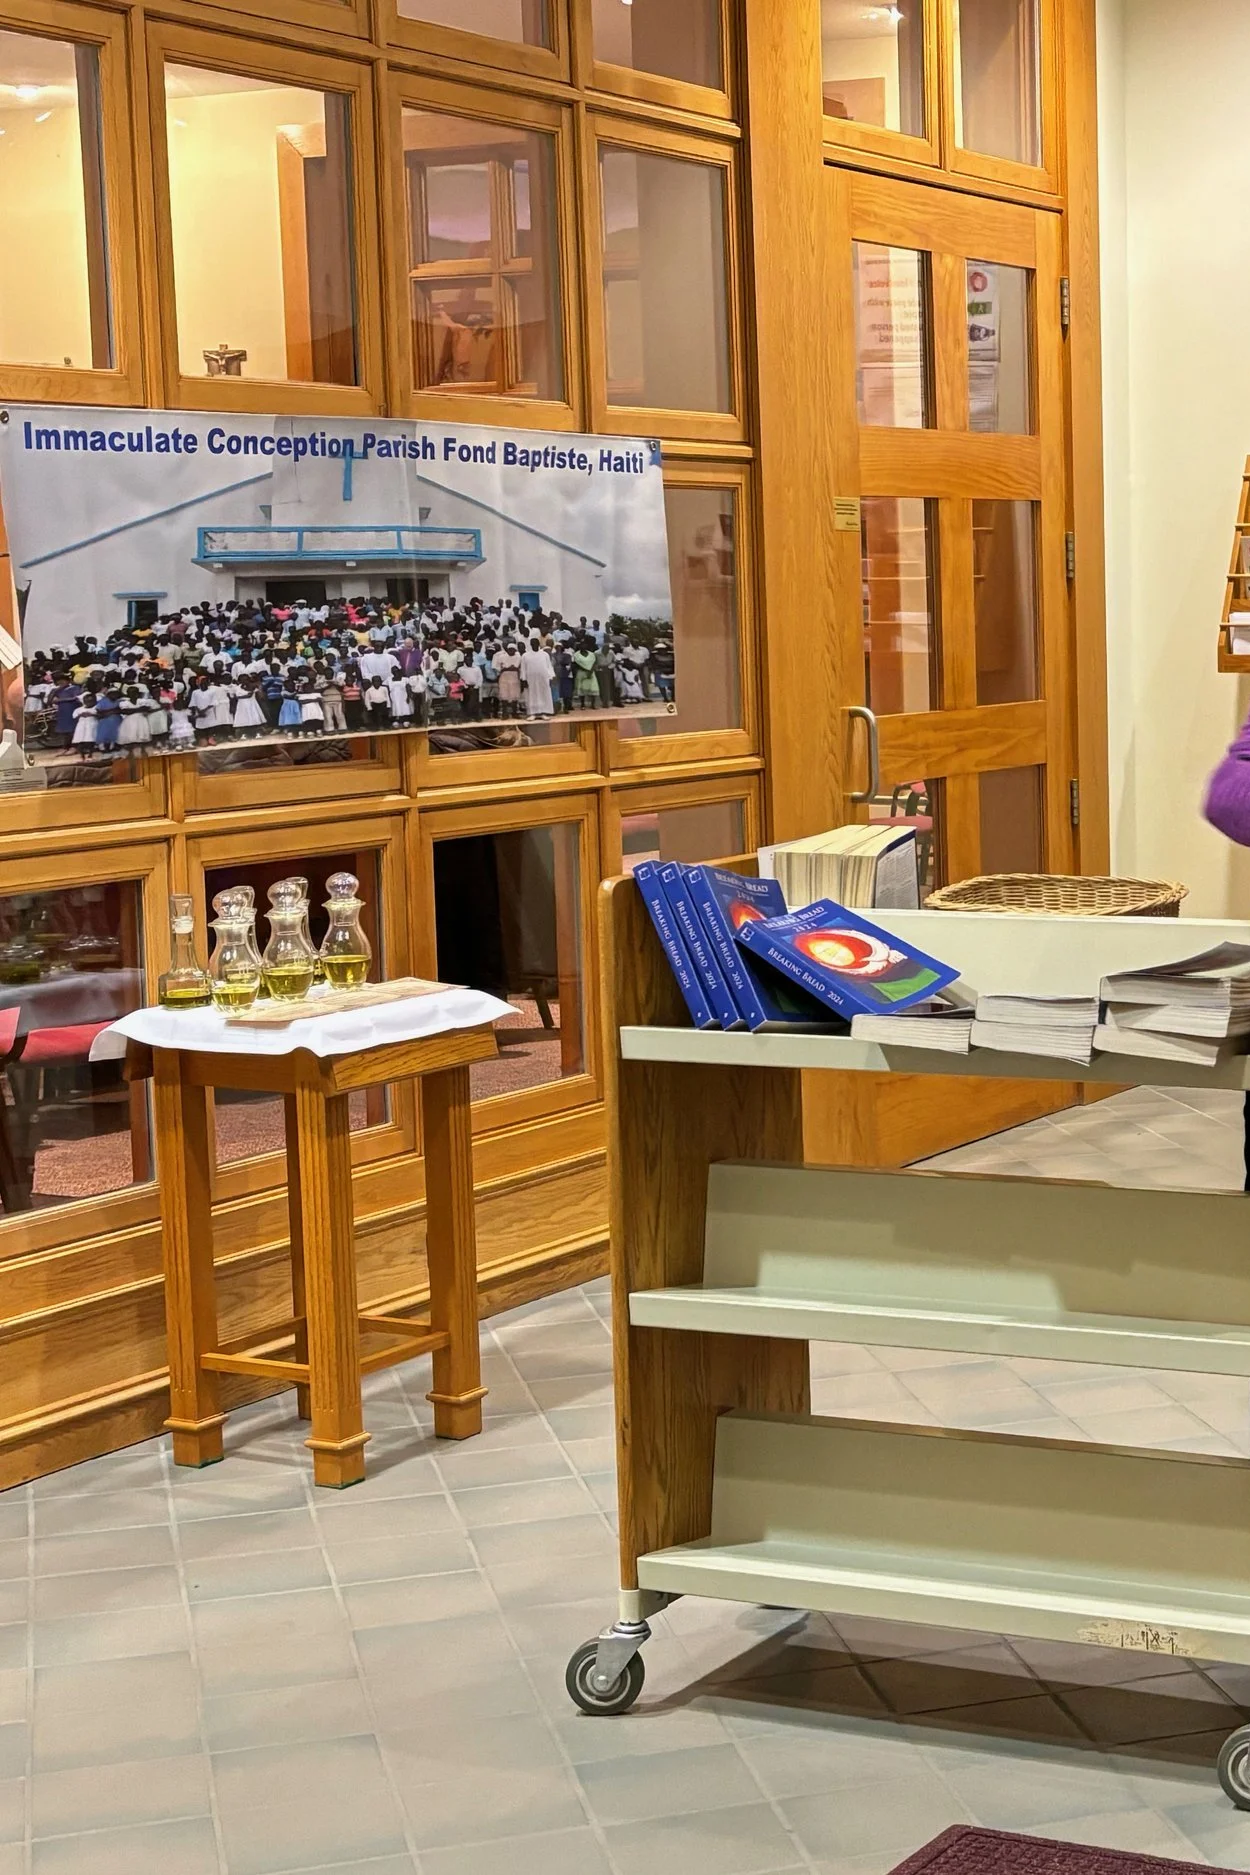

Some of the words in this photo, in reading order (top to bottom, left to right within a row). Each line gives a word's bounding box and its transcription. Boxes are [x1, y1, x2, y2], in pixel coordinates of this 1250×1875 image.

[23, 421, 198, 454] Immaculate
[207, 427, 355, 462] Conception
[362, 432, 436, 460] Parish
[443, 437, 497, 465] Fond
[503, 441, 593, 475] Baptiste,
[598, 449, 644, 474] Haiti
[651, 899, 672, 940] BREAKING
[667, 940, 682, 967] BREAD
[679, 970, 692, 989] 2024
[676, 901, 698, 941] BREAKING
[693, 941, 709, 968] BREAD
[704, 970, 718, 990] 2024
[702, 901, 724, 941] BREAKING
[719, 941, 735, 968] BREAD
[731, 970, 745, 990] 2024
[767, 947, 803, 976] BREAKING
[801, 972, 826, 992] BREAD
[826, 991, 844, 1006] 2024
